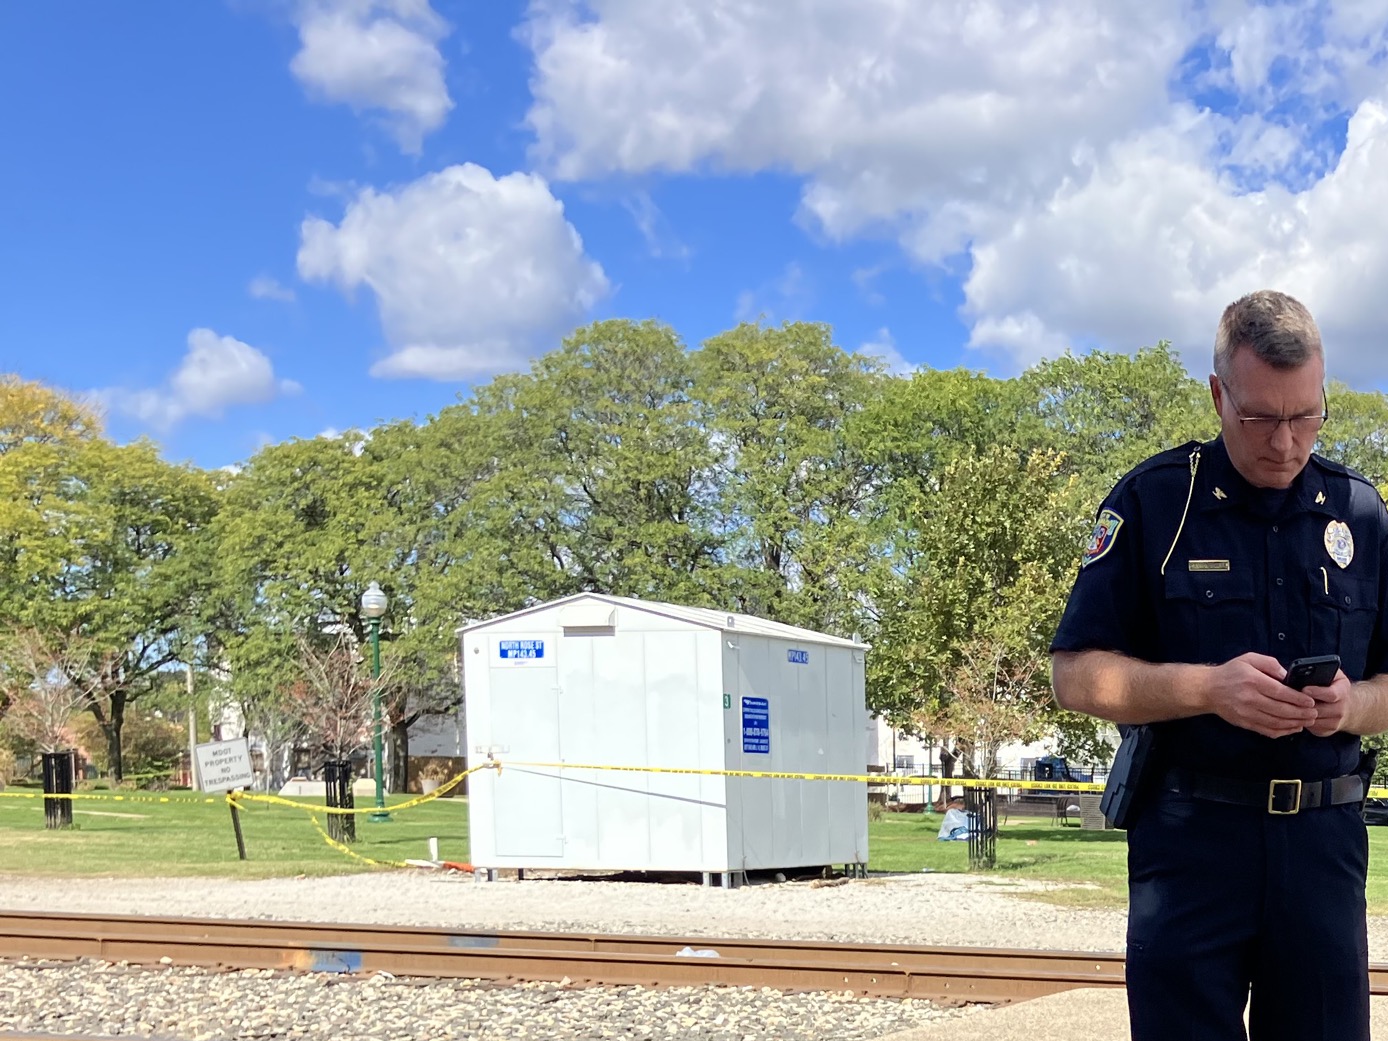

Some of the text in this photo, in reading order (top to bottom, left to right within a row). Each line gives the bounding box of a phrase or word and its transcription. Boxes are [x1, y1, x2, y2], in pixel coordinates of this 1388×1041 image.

[212, 747, 232, 757] MDOT
[204, 755, 243, 767] PROPERTY
[204, 772, 251, 786] TRESPASSING
